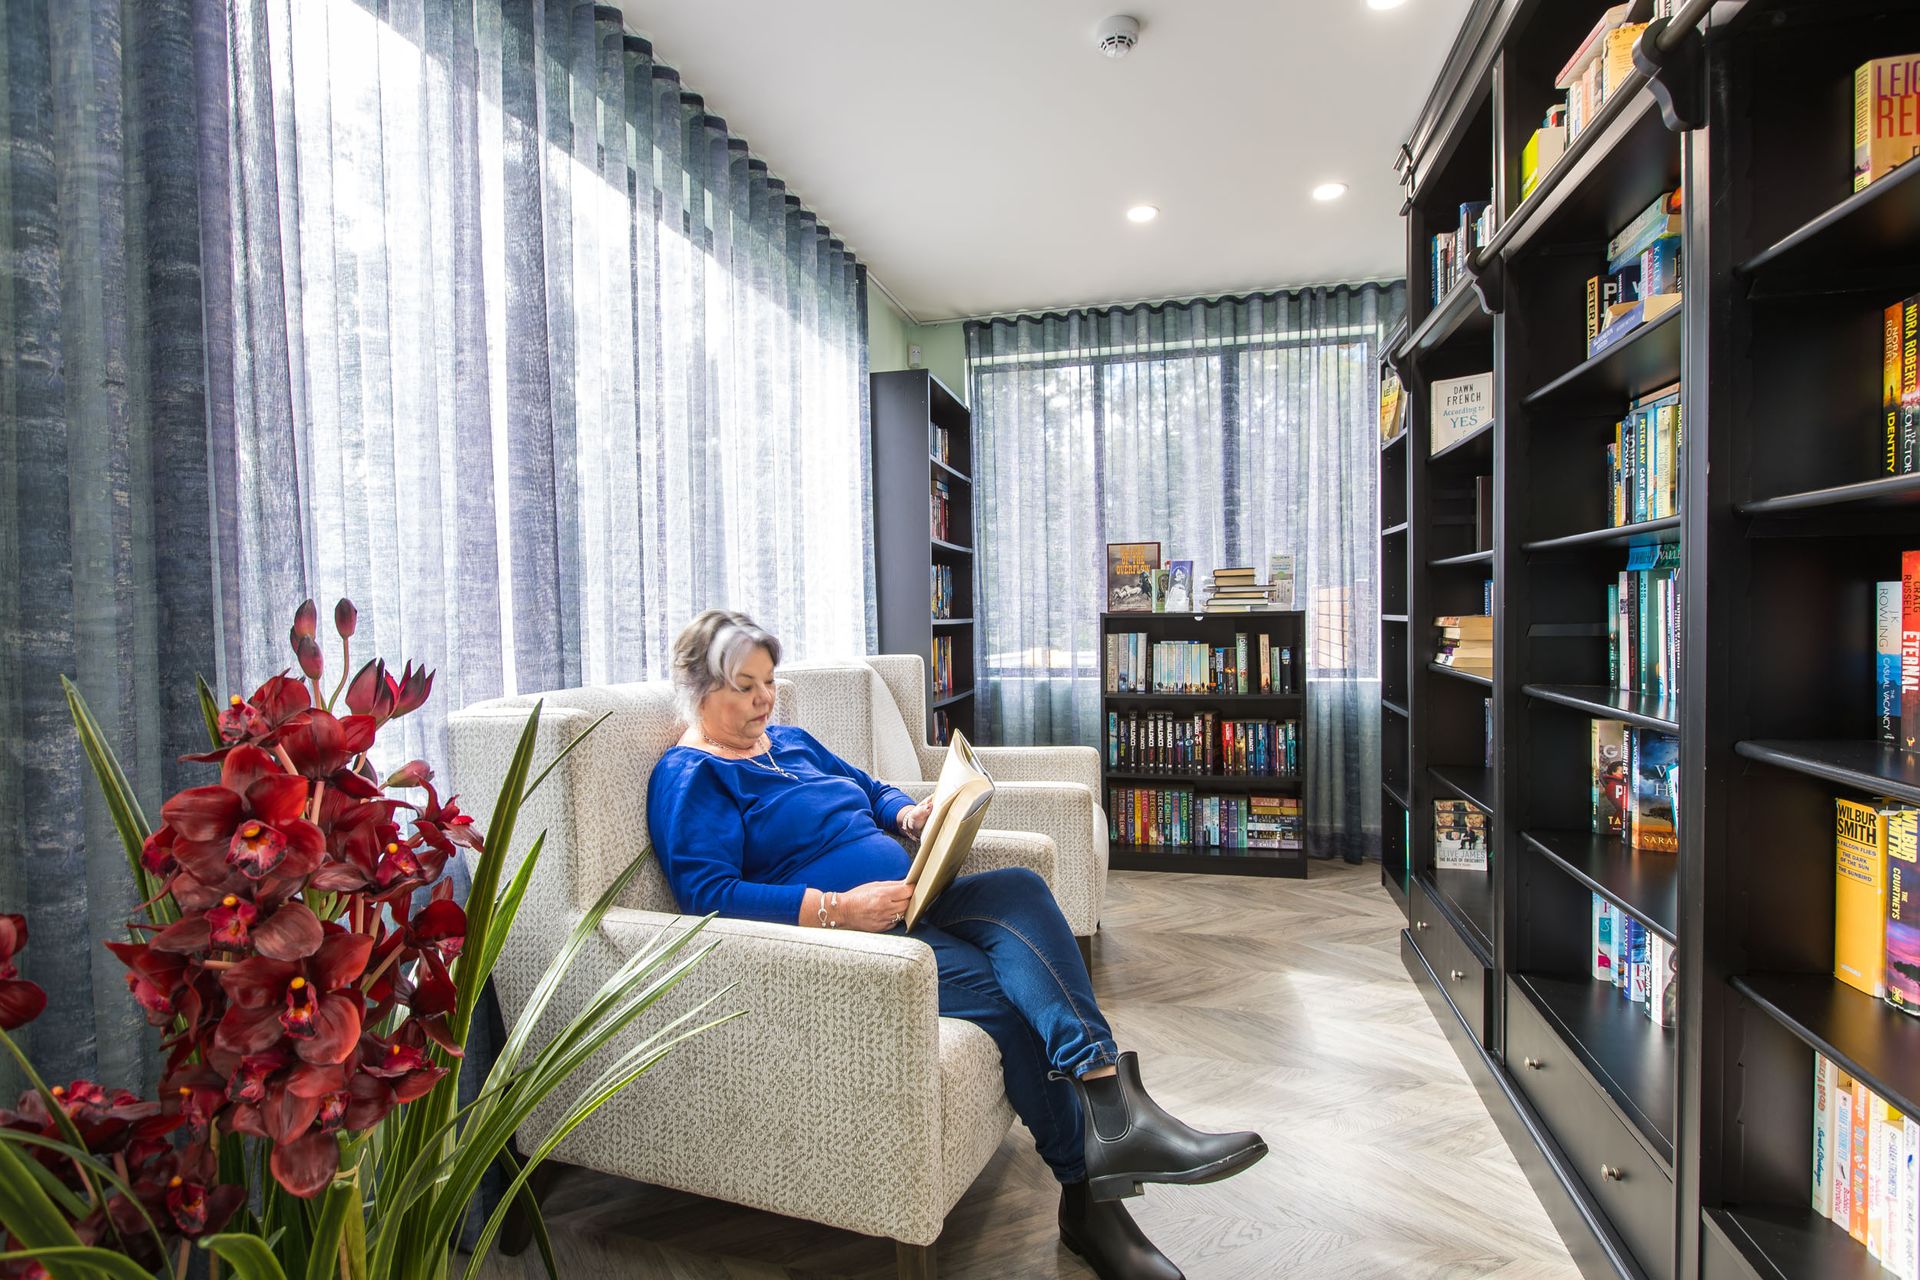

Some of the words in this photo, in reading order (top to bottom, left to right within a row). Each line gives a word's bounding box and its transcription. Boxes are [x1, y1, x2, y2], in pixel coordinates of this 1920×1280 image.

[1856, 97, 1868, 144] REDHEAD
[1904, 303, 1918, 340] NORA
[1904, 339, 1917, 395] ROBERTS
[1447, 392, 1481, 406] FRENCH
[1453, 383, 1474, 395] DAWN
[1443, 406, 1477, 417] According
[1450, 414, 1478, 429] YES
[1886, 411, 1896, 473] IDENTITY
[1904, 405, 1913, 474] COLLECTOR
[1116, 564, 1150, 575] OVERFLOW
[1903, 574, 1912, 620] RUSSELL
[1878, 588, 1888, 648] ROWLING
[1629, 629, 1635, 639] IT
[1902, 630, 1920, 694] ETERNAL
[1882, 690, 1890, 730] VACANCY
[1838, 803, 1877, 828] WILBUR
[1837, 817, 1877, 845] SMITH
[1888, 812, 1902, 859] MITH
[1901, 811, 1918, 864] WILBUR
[1462, 850, 1485, 858] JAMES
[1840, 840, 1859, 851] FALCON
[1860, 847, 1877, 857] FLIES
[1842, 851, 1851, 859] THE
[1852, 855, 1867, 864] DARK
[1838, 865, 1847, 874] THE
[1848, 869, 1872, 882] SUNBIRD
[1847, 859, 1856, 867] THE
[1858, 863, 1870, 871] SUN
[1891, 867, 1901, 920] COURTNEYS
